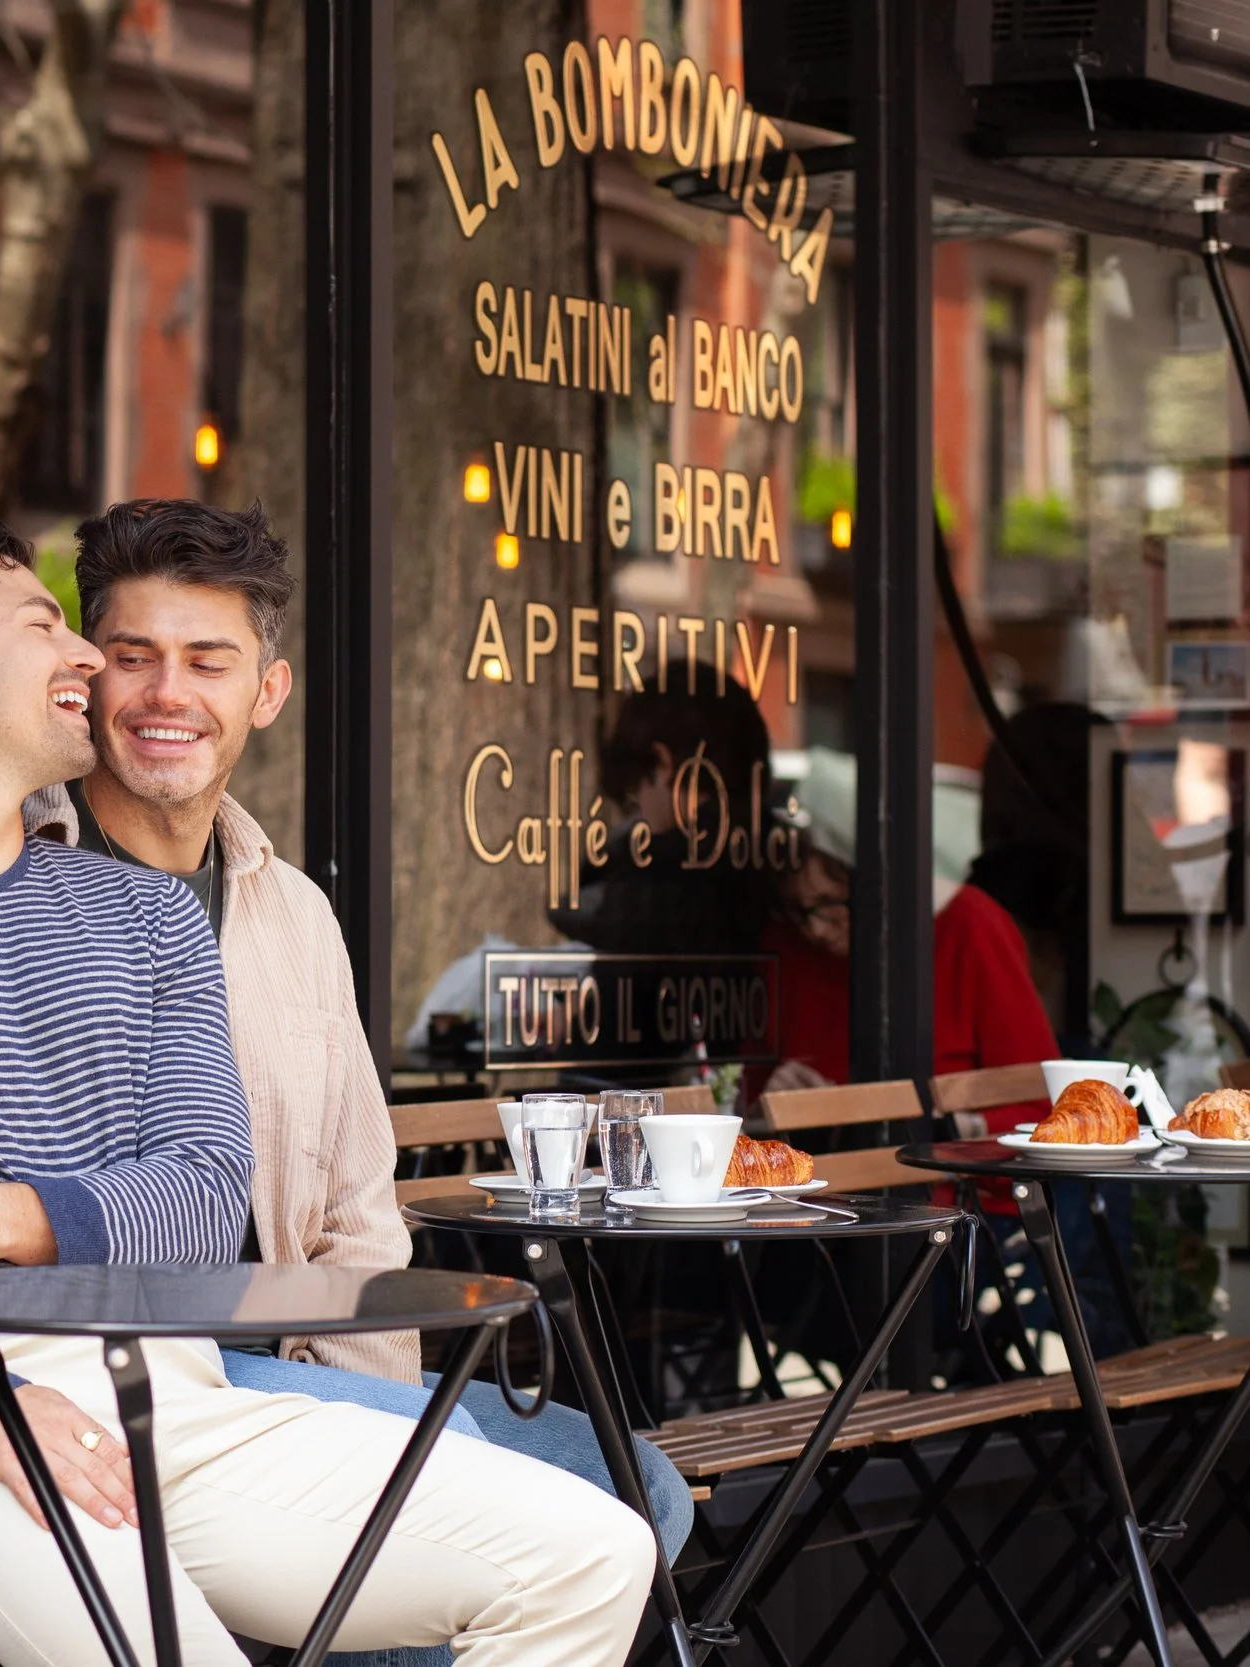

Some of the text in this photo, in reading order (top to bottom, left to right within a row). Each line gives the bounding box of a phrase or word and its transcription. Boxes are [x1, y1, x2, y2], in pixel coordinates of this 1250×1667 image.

[432, 36, 833, 303] LA BOMBONIERA
[475, 281, 803, 421] SALATINI al BANCO
[494, 441, 780, 565] VINI e BIRRA
[466, 598, 798, 704] APERITIVI
[464, 740, 803, 910] Caffé e Dolci
[498, 975, 769, 1047] TUTTO IL GIORNO
